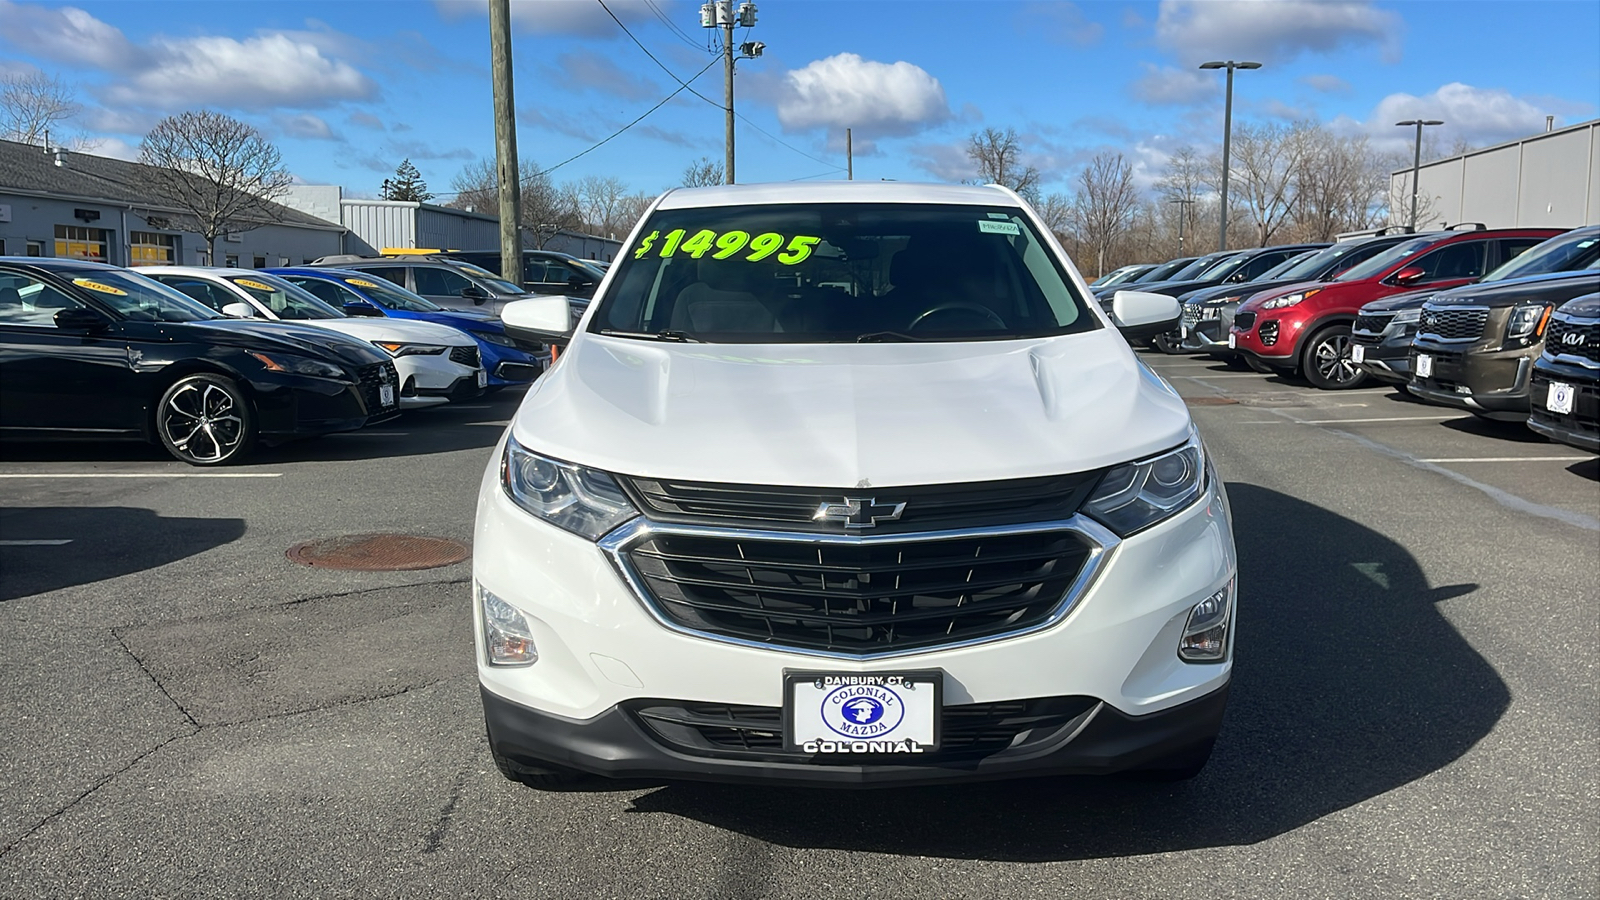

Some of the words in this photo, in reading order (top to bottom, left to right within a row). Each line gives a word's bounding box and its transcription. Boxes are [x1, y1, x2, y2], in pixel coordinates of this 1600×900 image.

[634, 229, 821, 265] $14995
[824, 676, 884, 686] DANBURY,
[887, 676, 904, 685] CT
[832, 687, 894, 707] COLONIAL
[839, 721, 888, 735] MAZDA
[803, 741, 923, 753] COLONIAL
